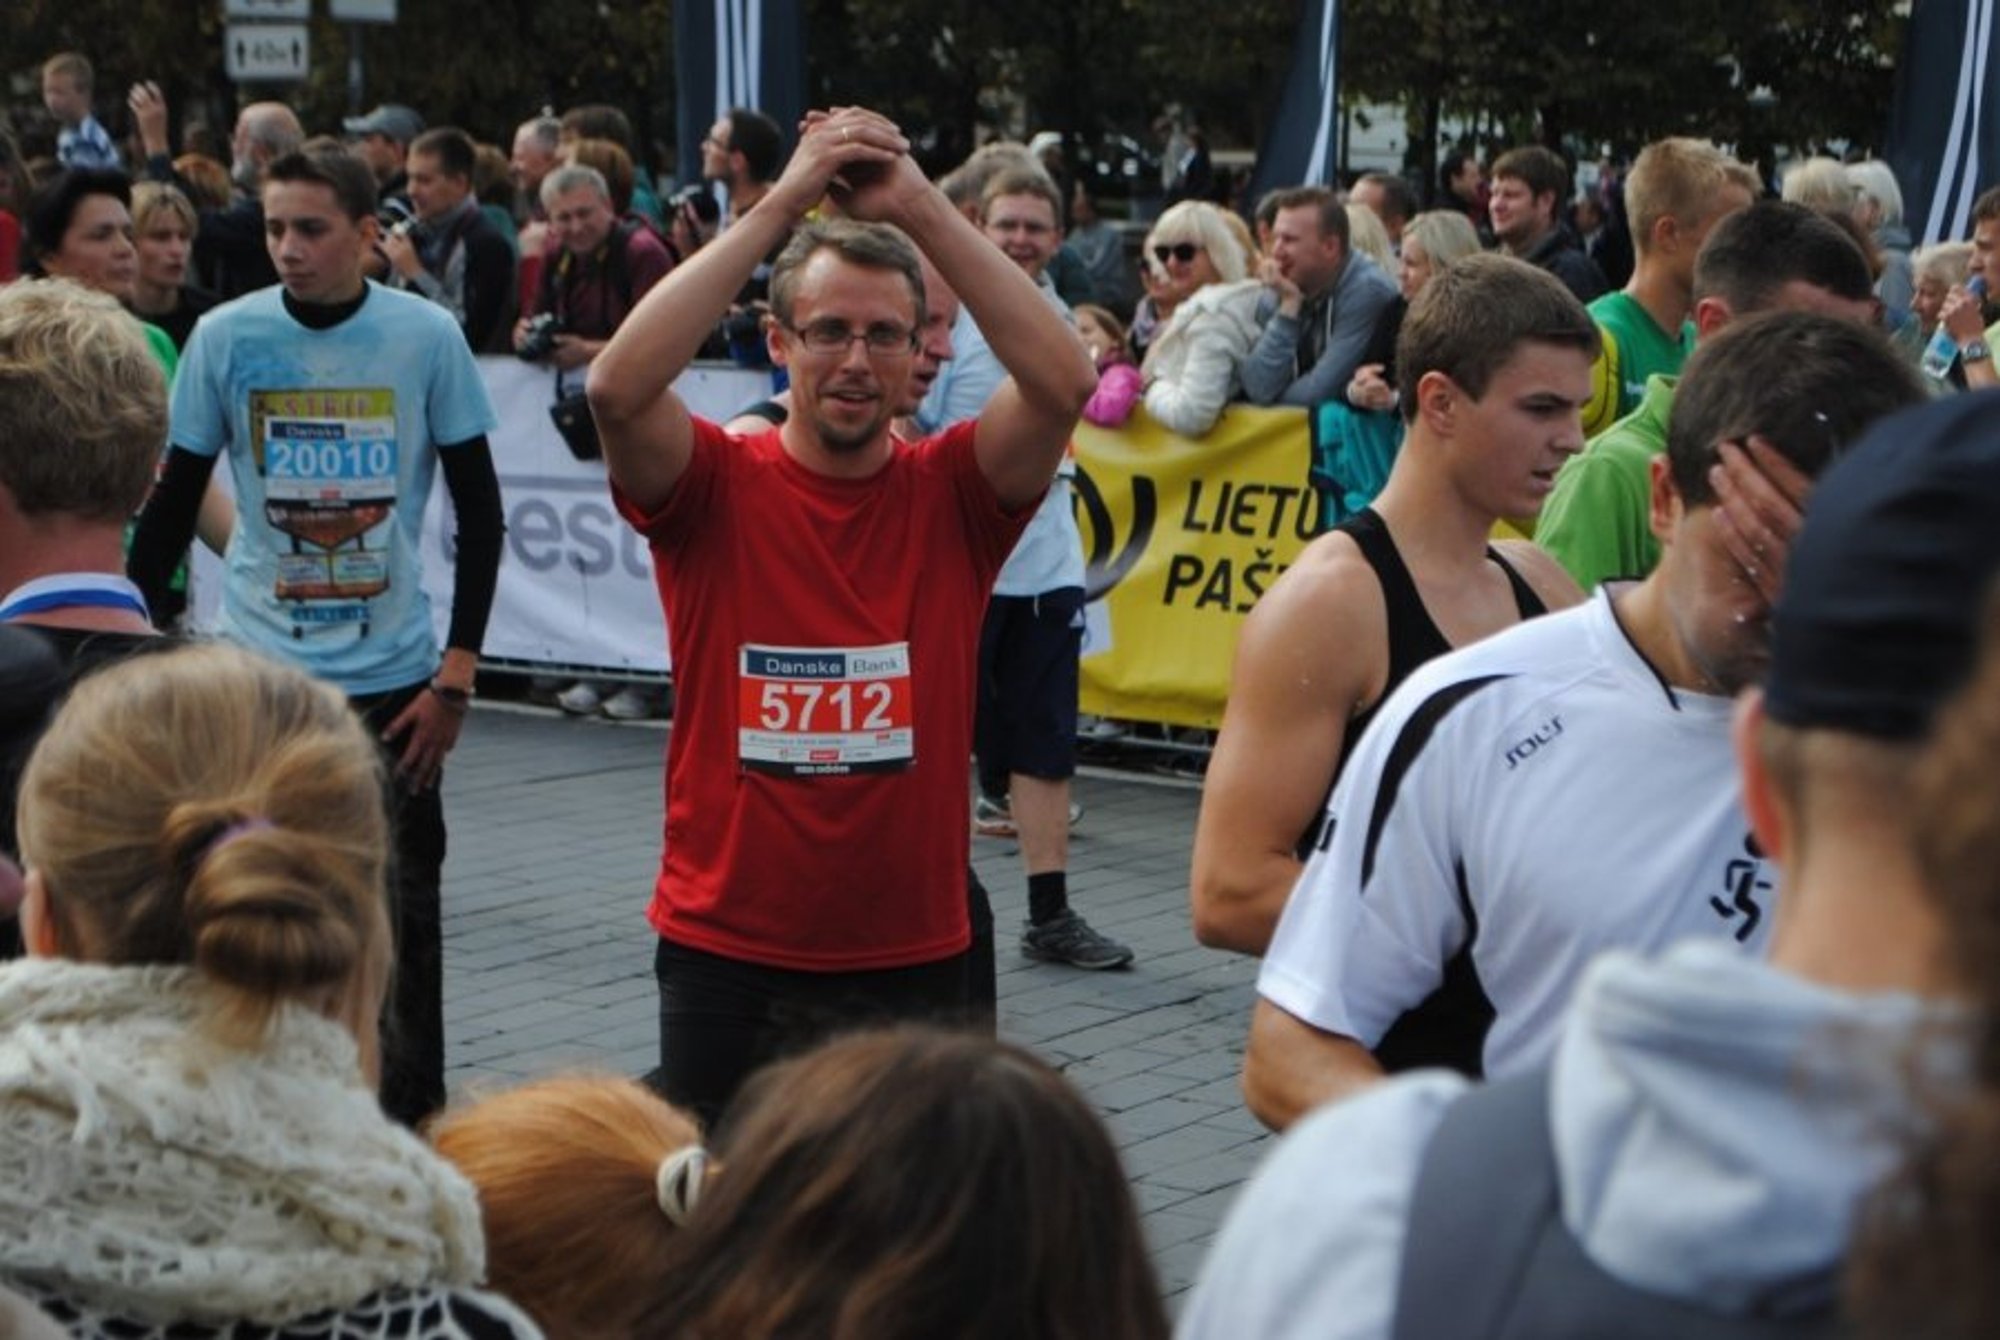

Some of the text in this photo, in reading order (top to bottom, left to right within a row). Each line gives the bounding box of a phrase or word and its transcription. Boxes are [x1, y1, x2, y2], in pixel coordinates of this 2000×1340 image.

[271, 442, 391, 478] 20010
[1162, 547, 1290, 614] PAŠ
[765, 658, 898, 675] Danske Bank
[760, 682, 893, 732] 5712
